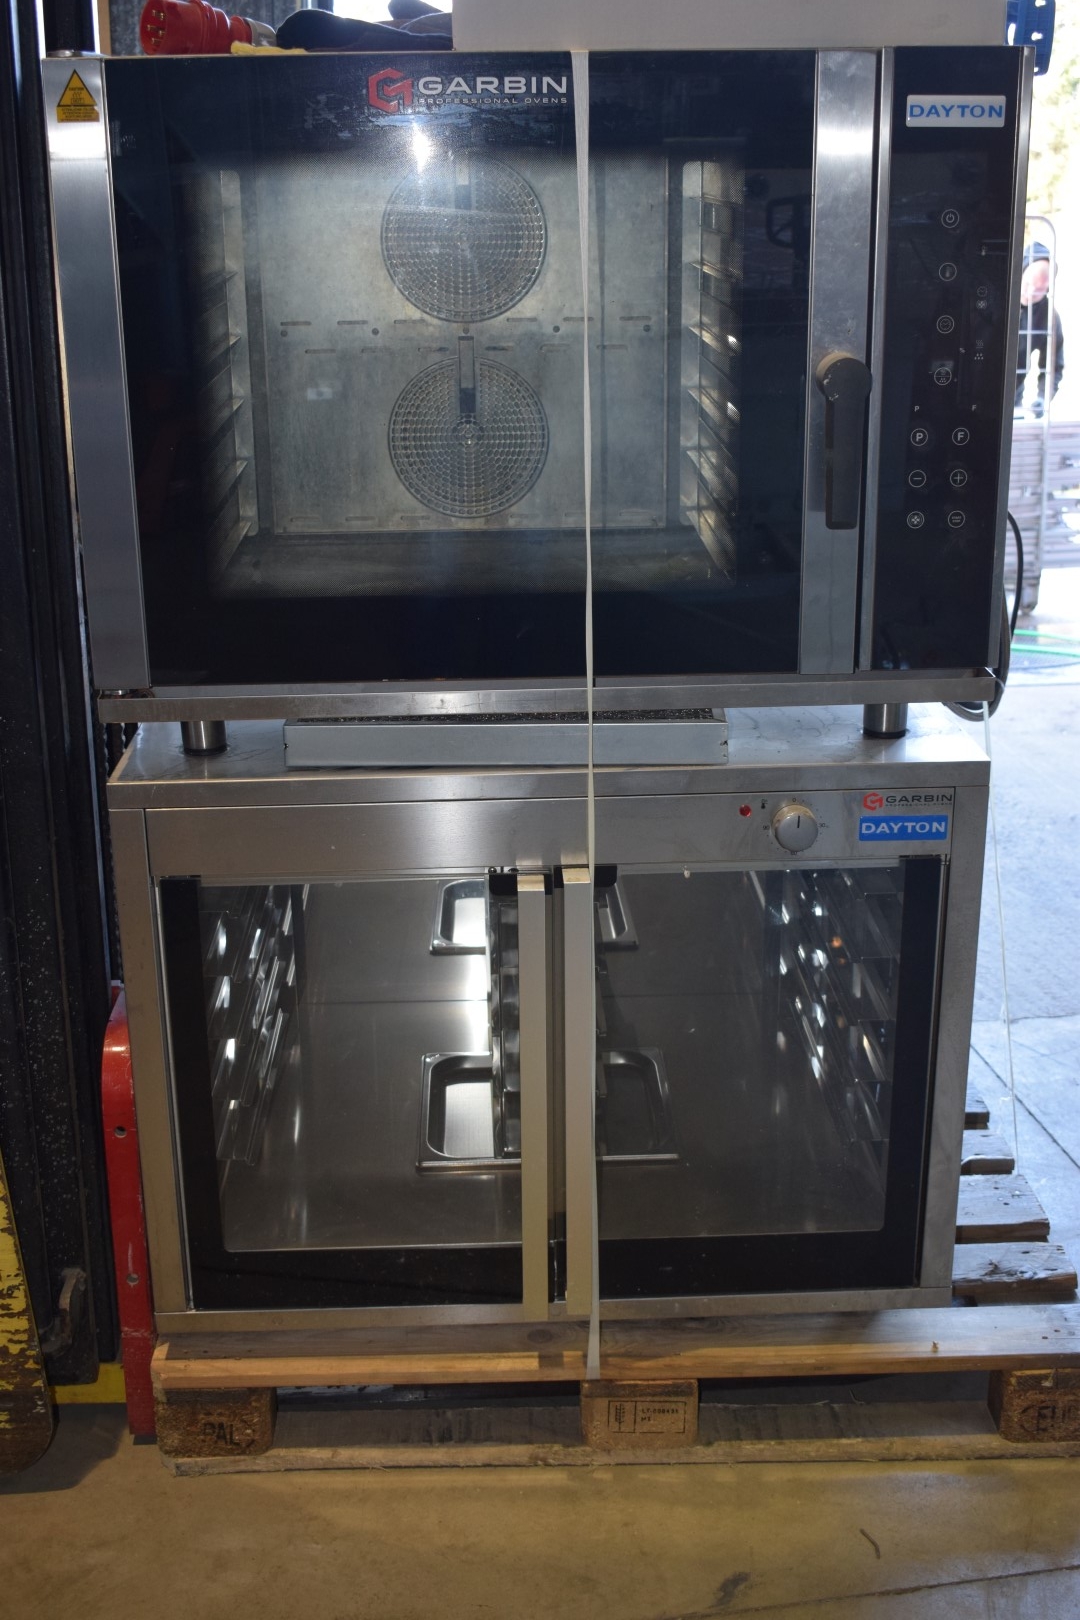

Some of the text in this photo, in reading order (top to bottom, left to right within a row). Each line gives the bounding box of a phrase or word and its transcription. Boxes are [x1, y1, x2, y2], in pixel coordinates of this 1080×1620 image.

[418, 76, 567, 94] GARBIN
[909, 104, 1003, 118] DAYTON
[915, 432, 924, 442] P
[957, 432, 965, 441] F
[885, 794, 953, 803] GARBIN
[861, 821, 946, 834] DAYTON
